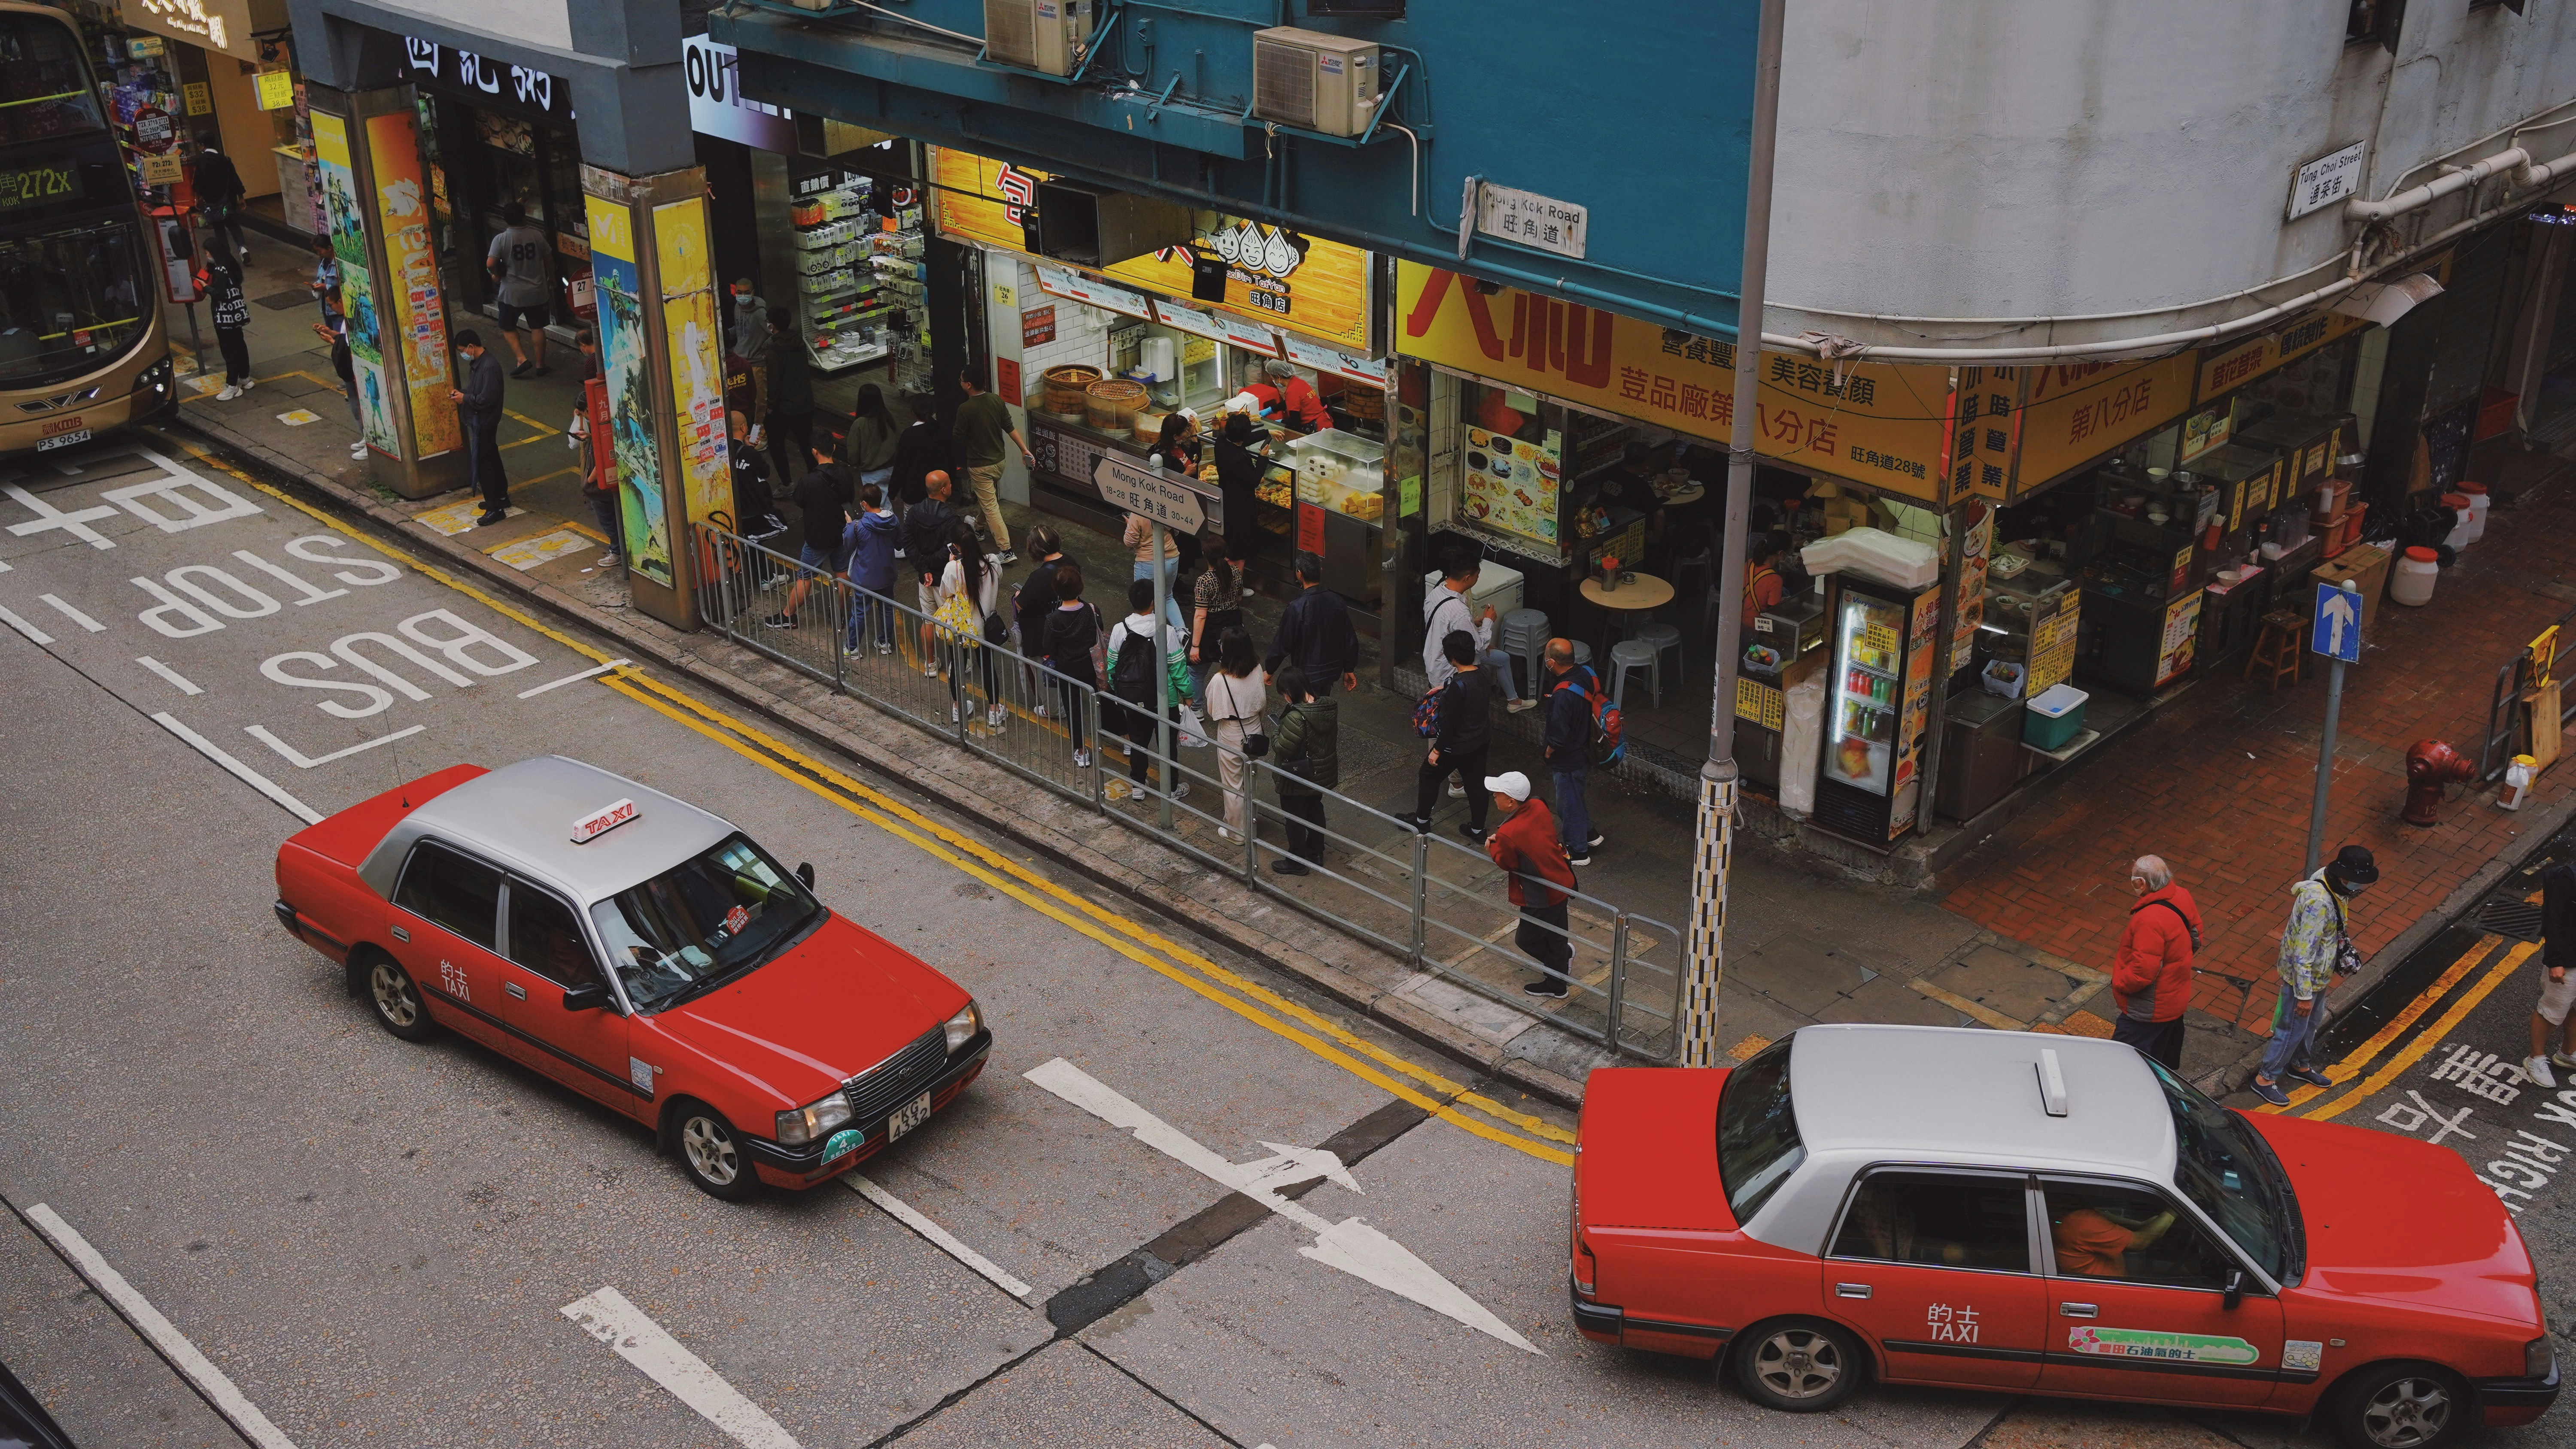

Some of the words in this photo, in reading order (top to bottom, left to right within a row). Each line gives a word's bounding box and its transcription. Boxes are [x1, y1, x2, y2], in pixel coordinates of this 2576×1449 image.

[268, 82, 285, 90] 32元
[271, 99, 288, 107] 38元
[2301, 170, 2318, 185] Tung
[2321, 160, 2337, 176] Choi
[2339, 148, 2362, 168] Street
[17, 168, 72, 199] 272X
[2309, 175, 2342, 206] 通菜街
[2, 196, 20, 207] KOK
[1521, 198, 1543, 215] Kok
[1548, 205, 1580, 224] Road
[1504, 214, 1559, 245] 旺角道
[513, 243, 535, 261] 88
[1226, 269, 1252, 284] aoDim
[1252, 274, 1286, 294] TatYan
[1250, 291, 1285, 313] 旺角店
[1771, 355, 1876, 407] 美容養顏
[2069, 377, 2153, 445] 第八分店
[53, 416, 83, 433] KMB
[39, 440, 55, 450] PS
[59, 431, 88, 445] 9654
[1850, 445, 1926, 479] 旺角道28號
[1112, 467, 1136, 488] Mong
[1139, 477, 1157, 494] Kok
[1160, 485, 1184, 504] Road
[1106, 485, 1125, 500] 18-28
[1130, 492, 1167, 519] 旺角道
[1171, 511, 1194, 526] 30-44
[130, 534, 404, 638] STOP
[1852, 596, 1886, 611] Verygood
[1868, 635, 1886, 644] 紙包飲品
[260, 608, 541, 719] BUS
[585, 802, 633, 835] TAXI
[440, 958, 468, 985] 的士
[442, 974, 471, 1003] TAXI
[893, 1108, 928, 1138] 4332
[900, 1101, 919, 1123] KG
[832, 1131, 851, 1143] TAXI
[838, 1138, 848, 1149] 4
[830, 1142, 857, 1160] SEATS
[1927, 1303, 1980, 1324] 的士
[1927, 1322, 1979, 1343] TAXI
[2098, 1343, 2196, 1360] 豐田石油氣的士
